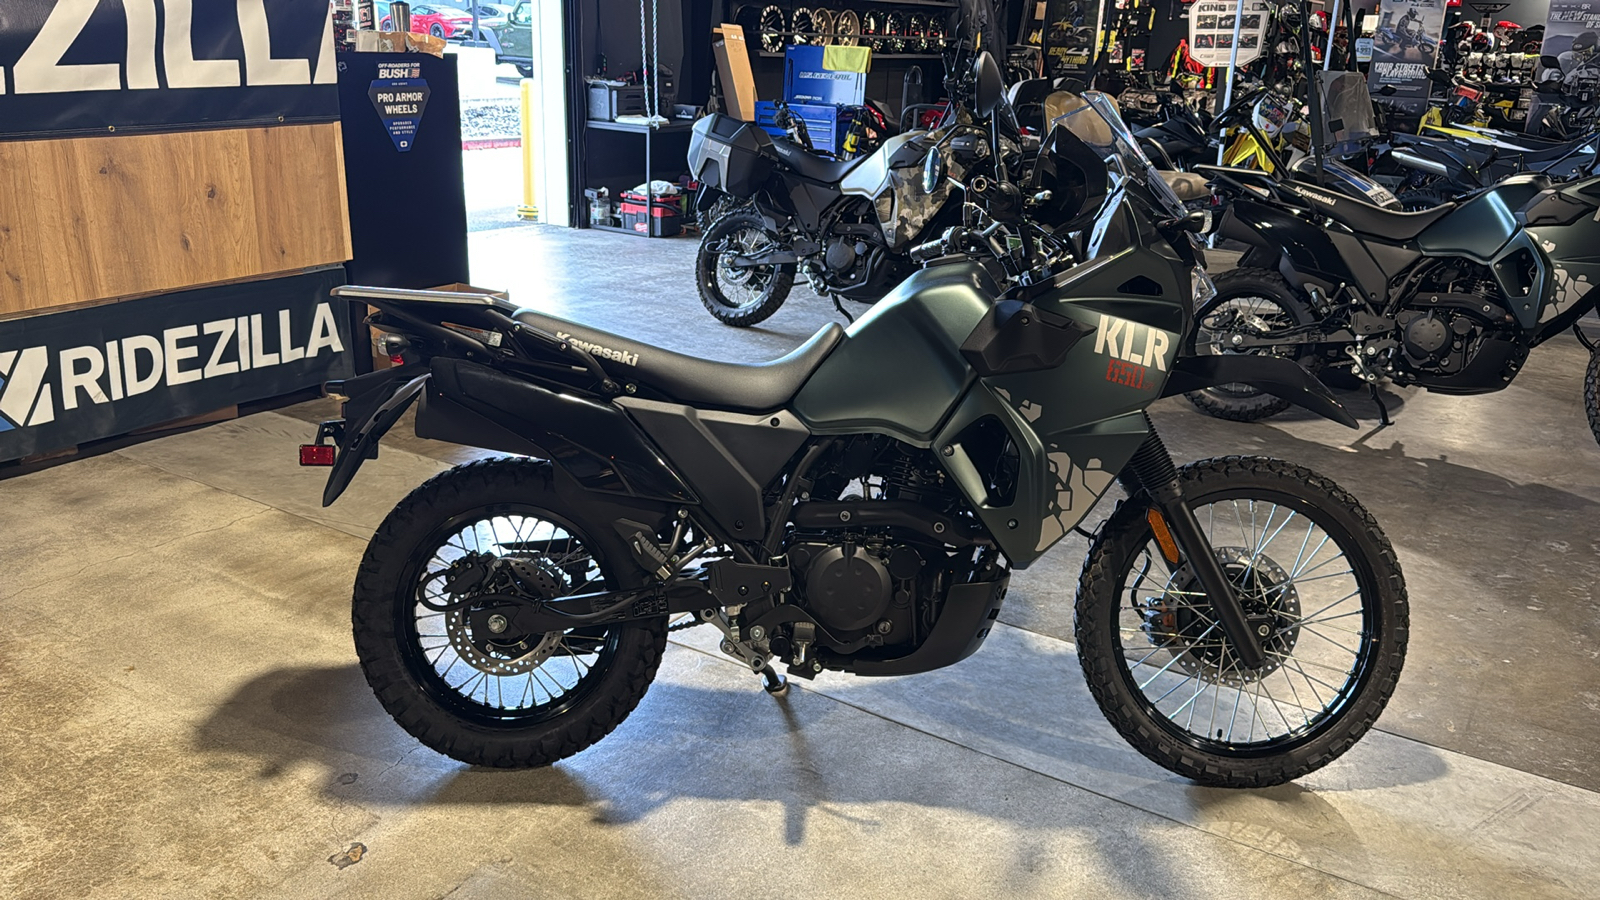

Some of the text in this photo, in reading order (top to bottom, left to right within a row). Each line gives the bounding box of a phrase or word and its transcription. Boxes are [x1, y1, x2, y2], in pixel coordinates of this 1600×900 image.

[1198, 4, 1226, 12] KING
[0, 0, 337, 94] ZILL
[1374, 62, 1394, 71] YOUR
[379, 68, 408, 79] BUSH
[1380, 69, 1427, 79] PLAYGROUND
[377, 91, 423, 103] PRO ARMOR
[384, 104, 418, 115] WHEELS
[1294, 185, 1337, 206] Kawasaki
[1094, 314, 1168, 373] KLR
[59, 302, 344, 410] RIDEZILLA
[1105, 359, 1146, 390] 650
